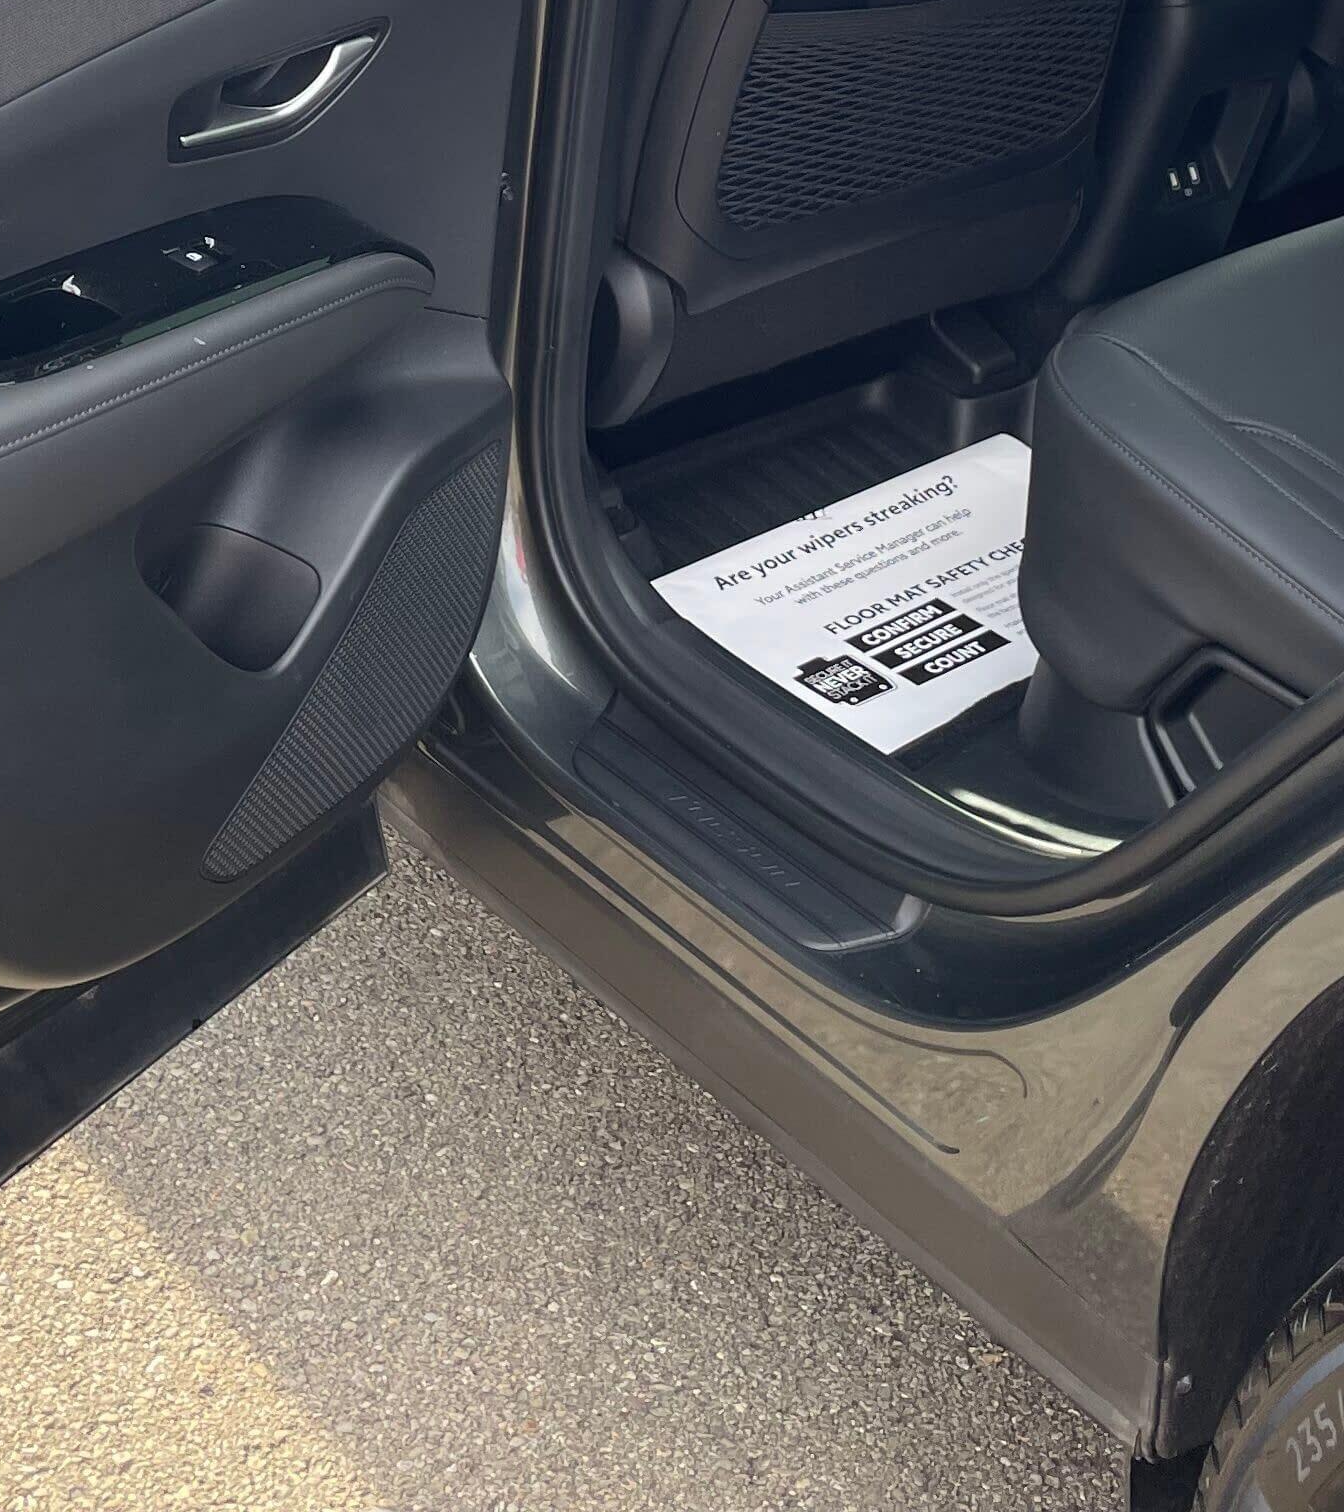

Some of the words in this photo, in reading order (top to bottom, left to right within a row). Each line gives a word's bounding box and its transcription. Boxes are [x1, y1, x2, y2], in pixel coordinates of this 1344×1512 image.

[713, 570, 752, 591] Are
[750, 549, 798, 578] your
[797, 520, 864, 554] wipers
[863, 474, 959, 526] streaking?
[753, 590, 785, 606] Your
[784, 566, 838, 594] Assistant
[834, 550, 878, 572] Service
[874, 528, 924, 554] Manager
[924, 519, 947, 532] can
[943, 507, 972, 524] help
[794, 589, 824, 605] with
[820, 575, 855, 594] these
[854, 552, 909, 581] questions
[908, 541, 931, 557] and
[824, 603, 890, 635] FLOOR
[885, 583, 928, 607] MAT
[925, 556, 989, 589] SAFETY
[988, 538, 1024, 561] CHE
[861, 604, 943, 647] CONFIRM
[894, 623, 964, 659] SECURE
[803, 663, 846, 685] SECURE
[924, 640, 987, 674] COUNT
[813, 665, 869, 693] NEVER
[826, 679, 871, 700] STACK
